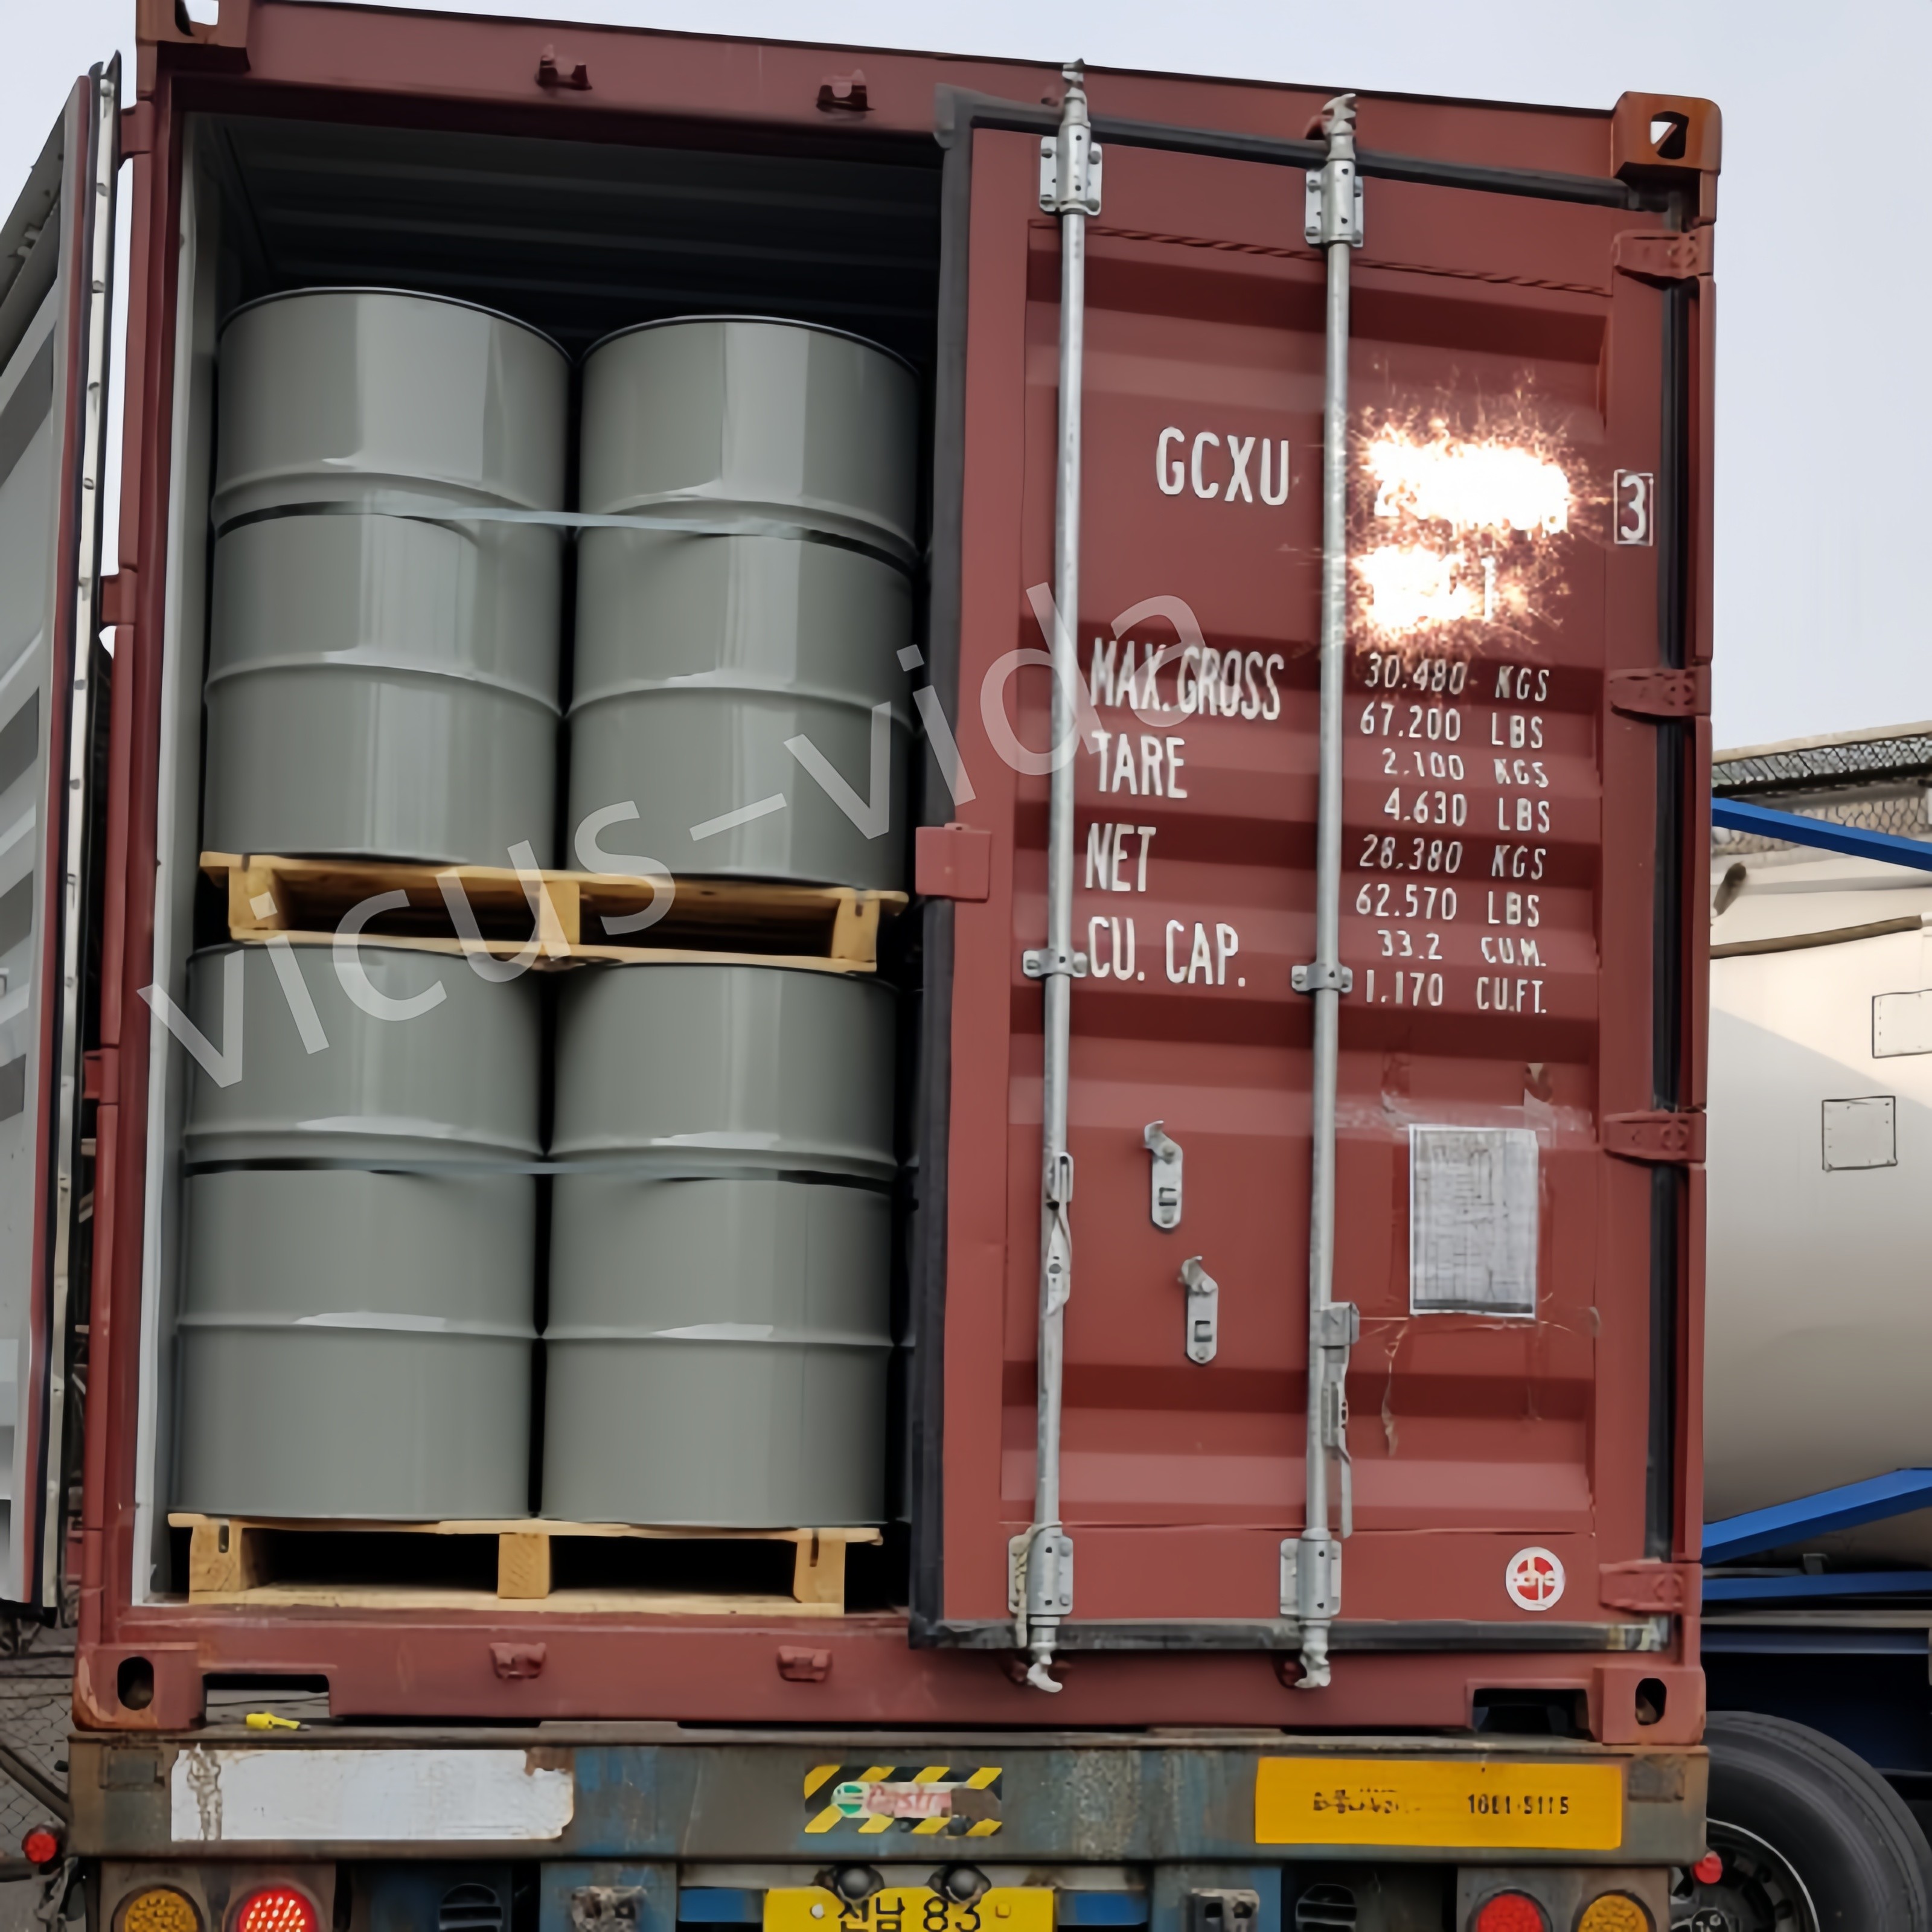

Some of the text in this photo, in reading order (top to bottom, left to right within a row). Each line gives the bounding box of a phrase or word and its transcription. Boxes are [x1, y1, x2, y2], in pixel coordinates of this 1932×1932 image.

[1156, 426, 1289, 506] GCXU
[1620, 475, 1646, 540] 3
[1364, 650, 1467, 695] 30.480
[1495, 665, 1550, 702] KGS
[1360, 701, 1543, 749] 67.200 LBS
[1090, 728, 1549, 798] TARE 2.100 KGS
[1384, 787, 1550, 833] 4.630 LBS
[1085, 823, 1156, 892] NET
[1491, 845, 1546, 880] KGS
[1355, 883, 1540, 927] 62.570 LBS
[1088, 916, 1145, 981] CU.
[1166, 920, 1246, 987] CAP.
[1377, 929, 1443, 960] 33.2
[1366, 969, 1443, 1006] 1.170
